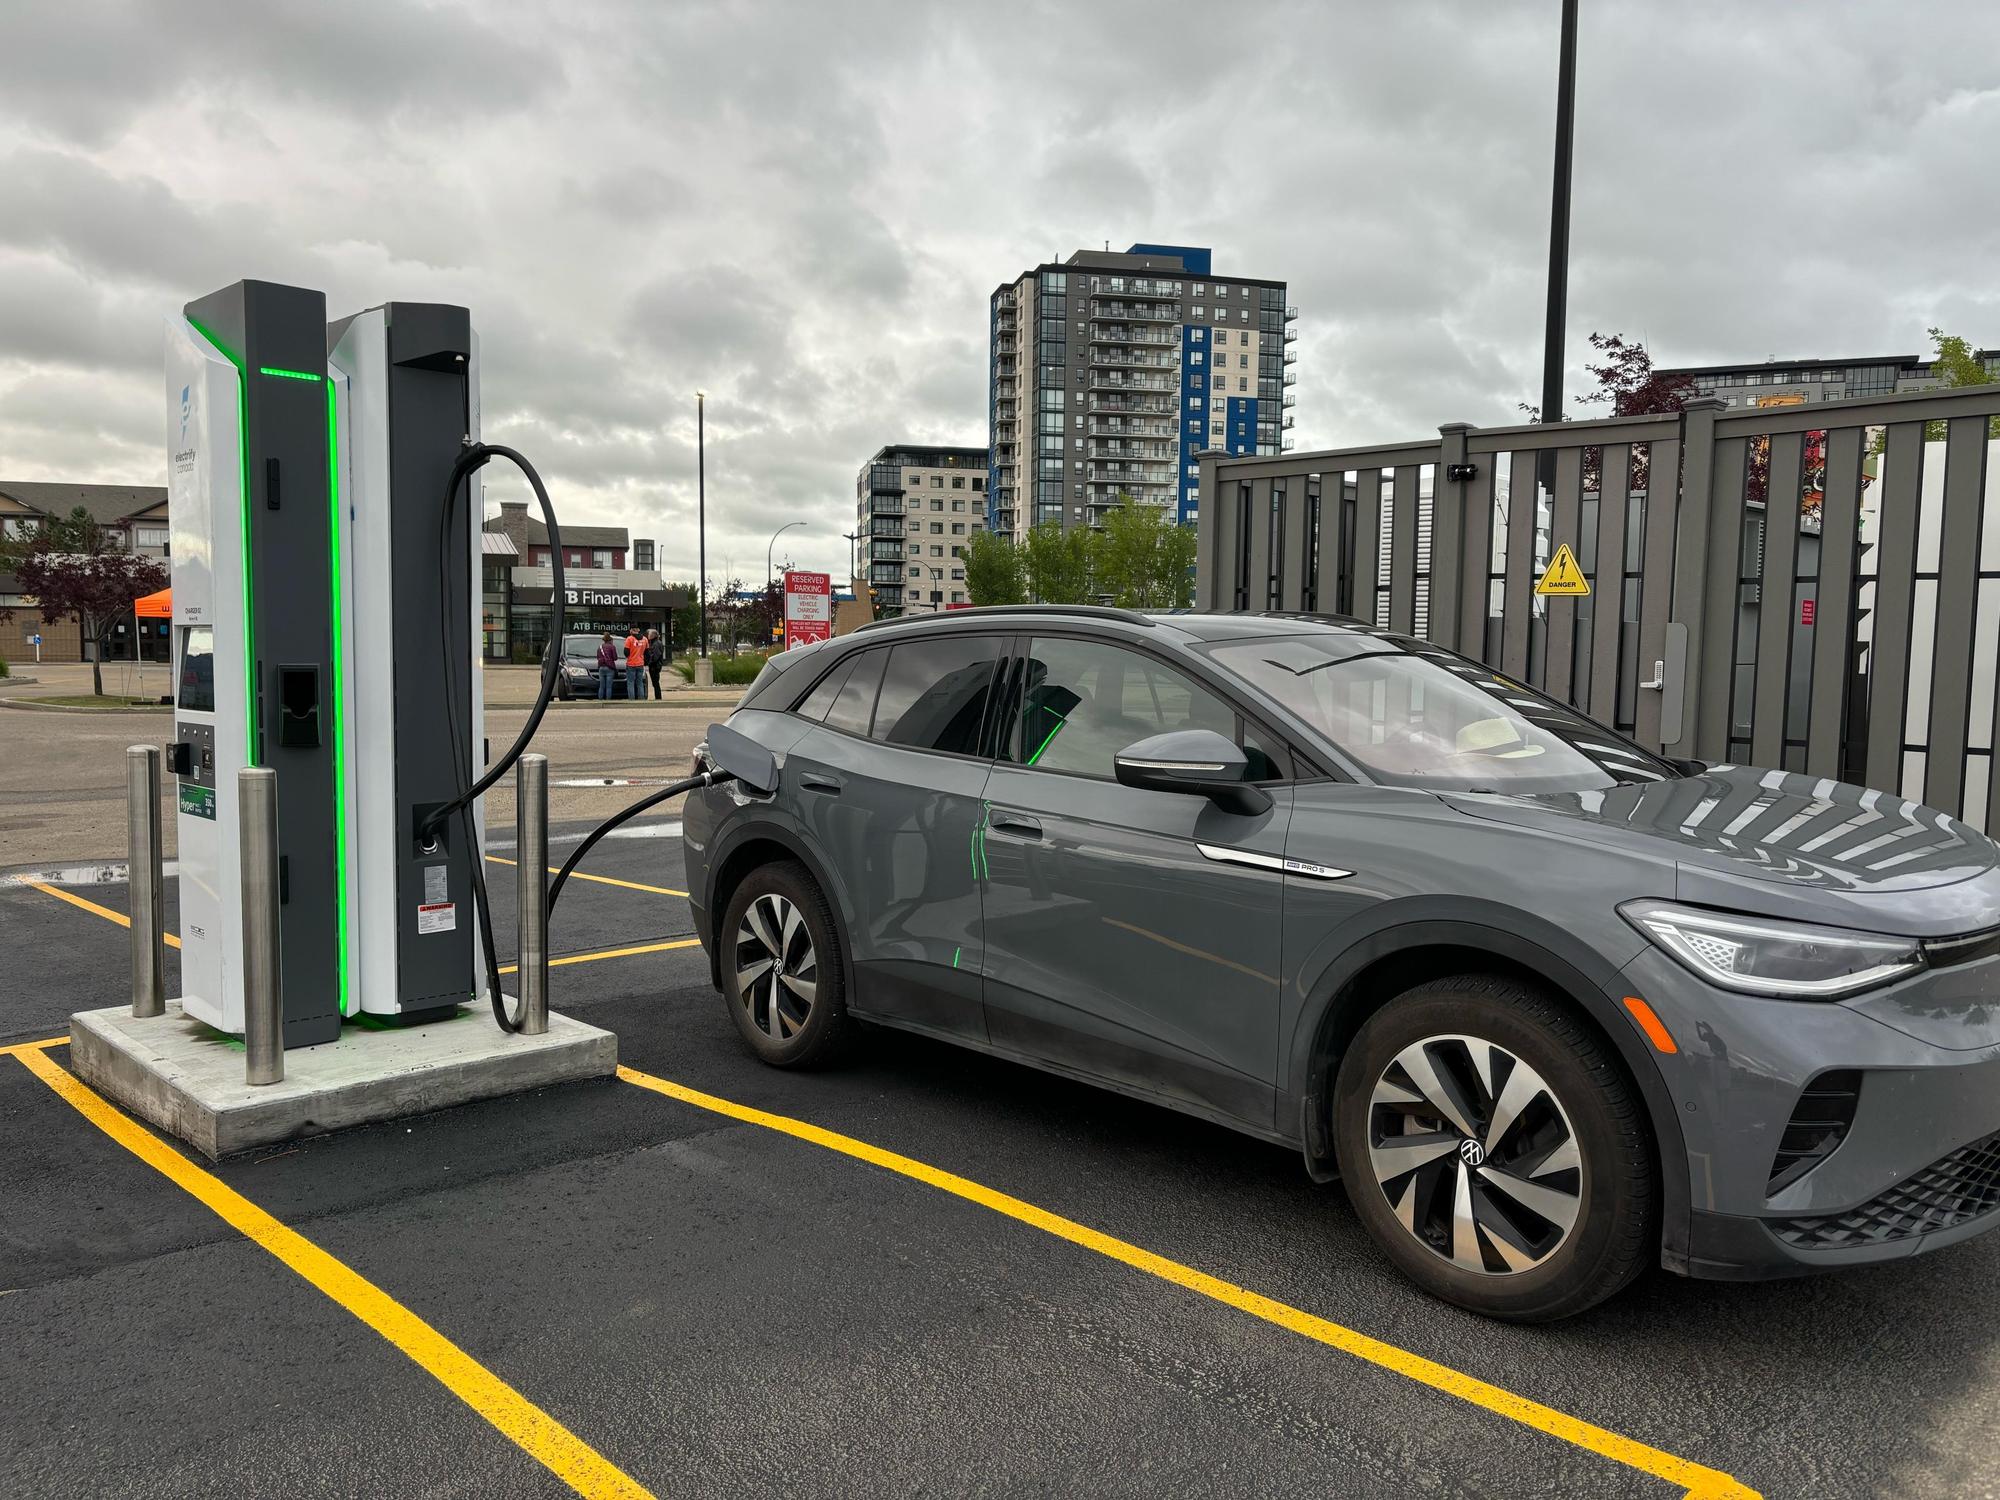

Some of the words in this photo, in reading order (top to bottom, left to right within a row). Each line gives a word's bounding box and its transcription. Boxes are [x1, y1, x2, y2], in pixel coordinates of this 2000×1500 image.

[792, 575, 824, 583] RESERVED
[583, 590, 644, 606] Financial
[573, 622, 591, 630] ATB
[593, 622, 631, 632] Financial
[180, 797, 195, 813] Hyper
